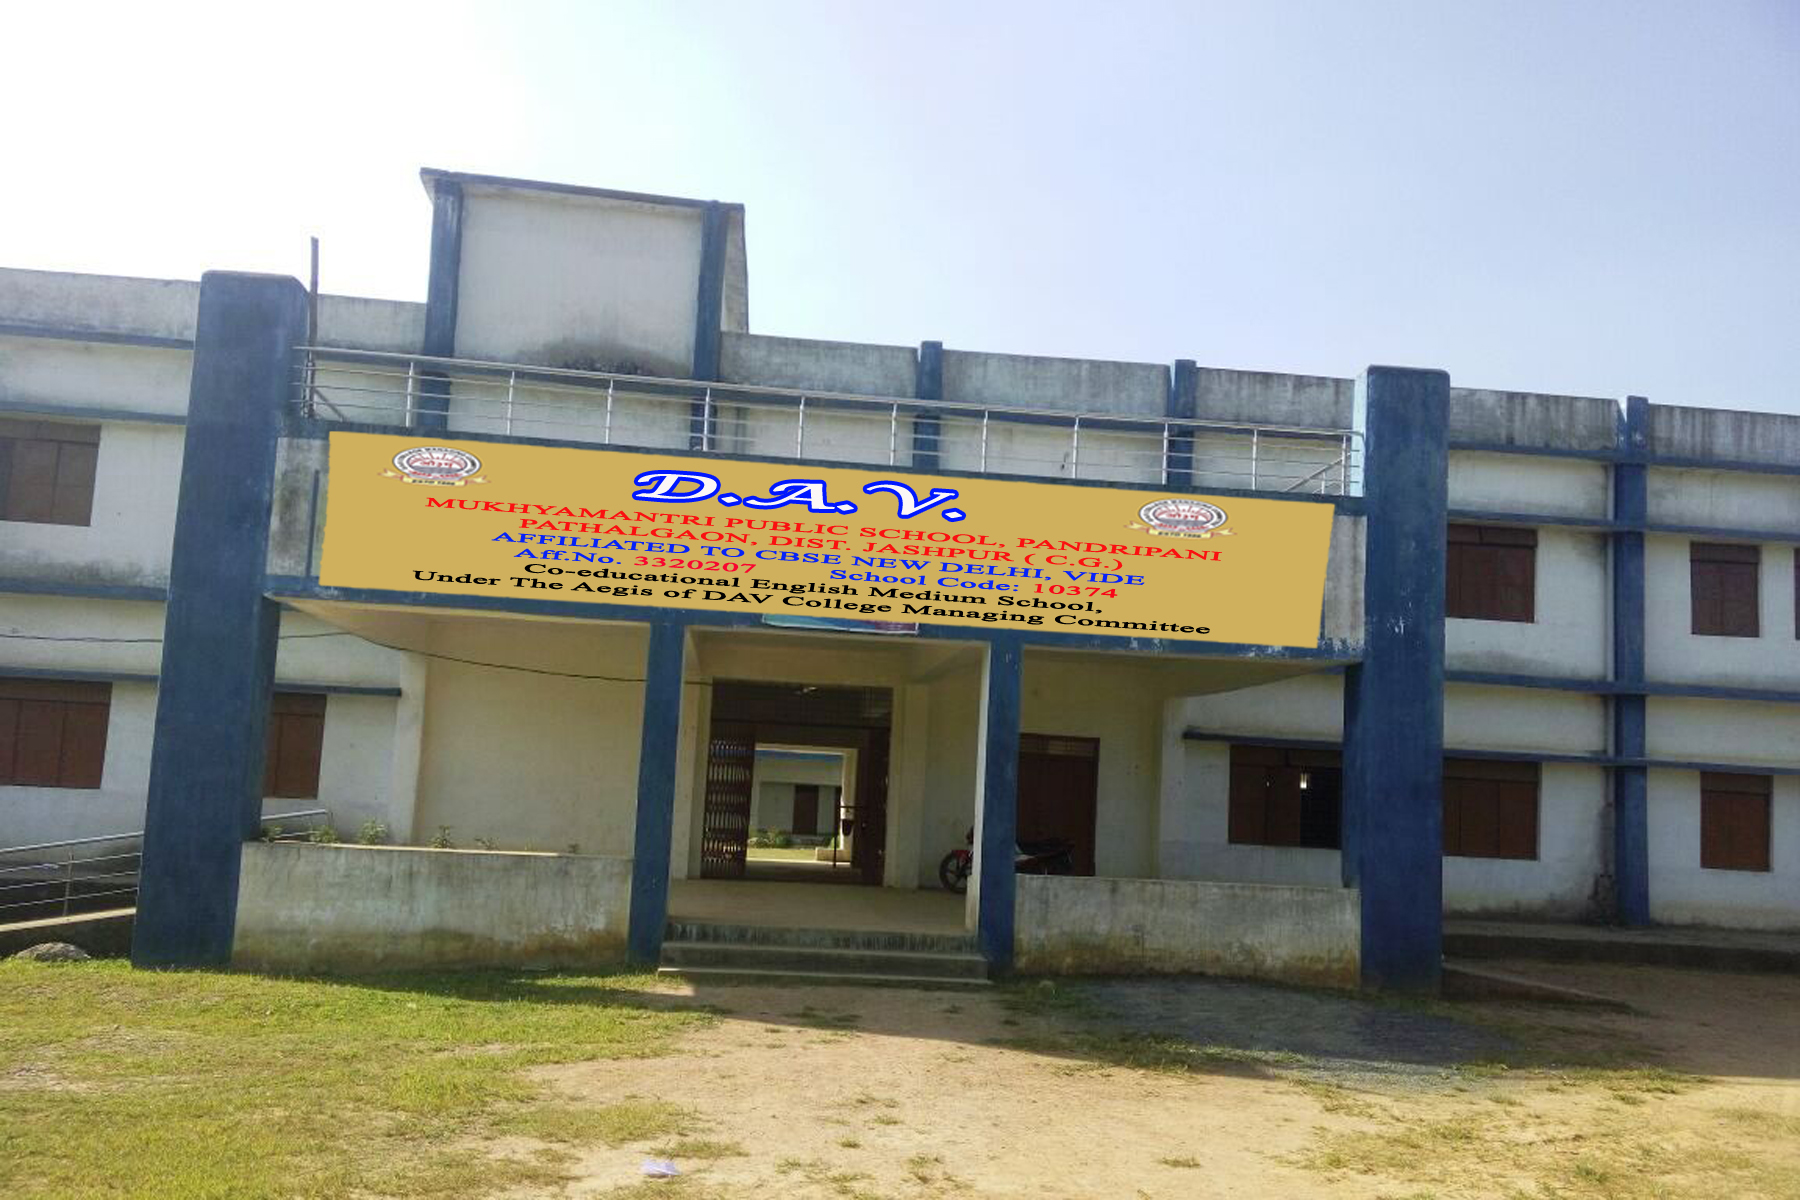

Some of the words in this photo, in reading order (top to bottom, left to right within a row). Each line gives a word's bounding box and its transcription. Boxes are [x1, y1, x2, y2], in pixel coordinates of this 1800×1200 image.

[426, 498, 715, 527] MUKHYAMANTRI
[724, 517, 848, 536] PUBLIC
[860, 527, 1005, 549] SCHOOL,
[1016, 537, 1222, 562] PANDRIPANI
[519, 518, 757, 546] PATHALGAON,
[769, 535, 850, 551] DIST.
[863, 542, 1014, 562] JASHPUR
[492, 532, 690, 554] AFFILIATED
[701, 545, 744, 558] TO
[755, 549, 841, 565] CBSE
[852, 556, 930, 571] NEW
[938, 562, 1051, 581] DELHI,
[1063, 570, 1145, 585] VIDE
[634, 556, 756, 574] 3320207
[830, 569, 927, 585] School
[938, 577, 1019, 591] Code:
[1034, 583, 1118, 599] 10374
[413, 570, 500, 585] Under
[510, 576, 564, 590] The
[571, 582, 653, 597] Aegis
[663, 588, 697, 599] of
[702, 590, 773, 604] DAV
[783, 596, 891, 613] College
[901, 604, 1044, 626] Managing
[1055, 615, 1211, 635] Committee
[525, 563, 740, 588] Co-educational
[750, 579, 858, 596] English
[868, 586, 986, 604] Medium
[997, 596, 1103, 614] School,
